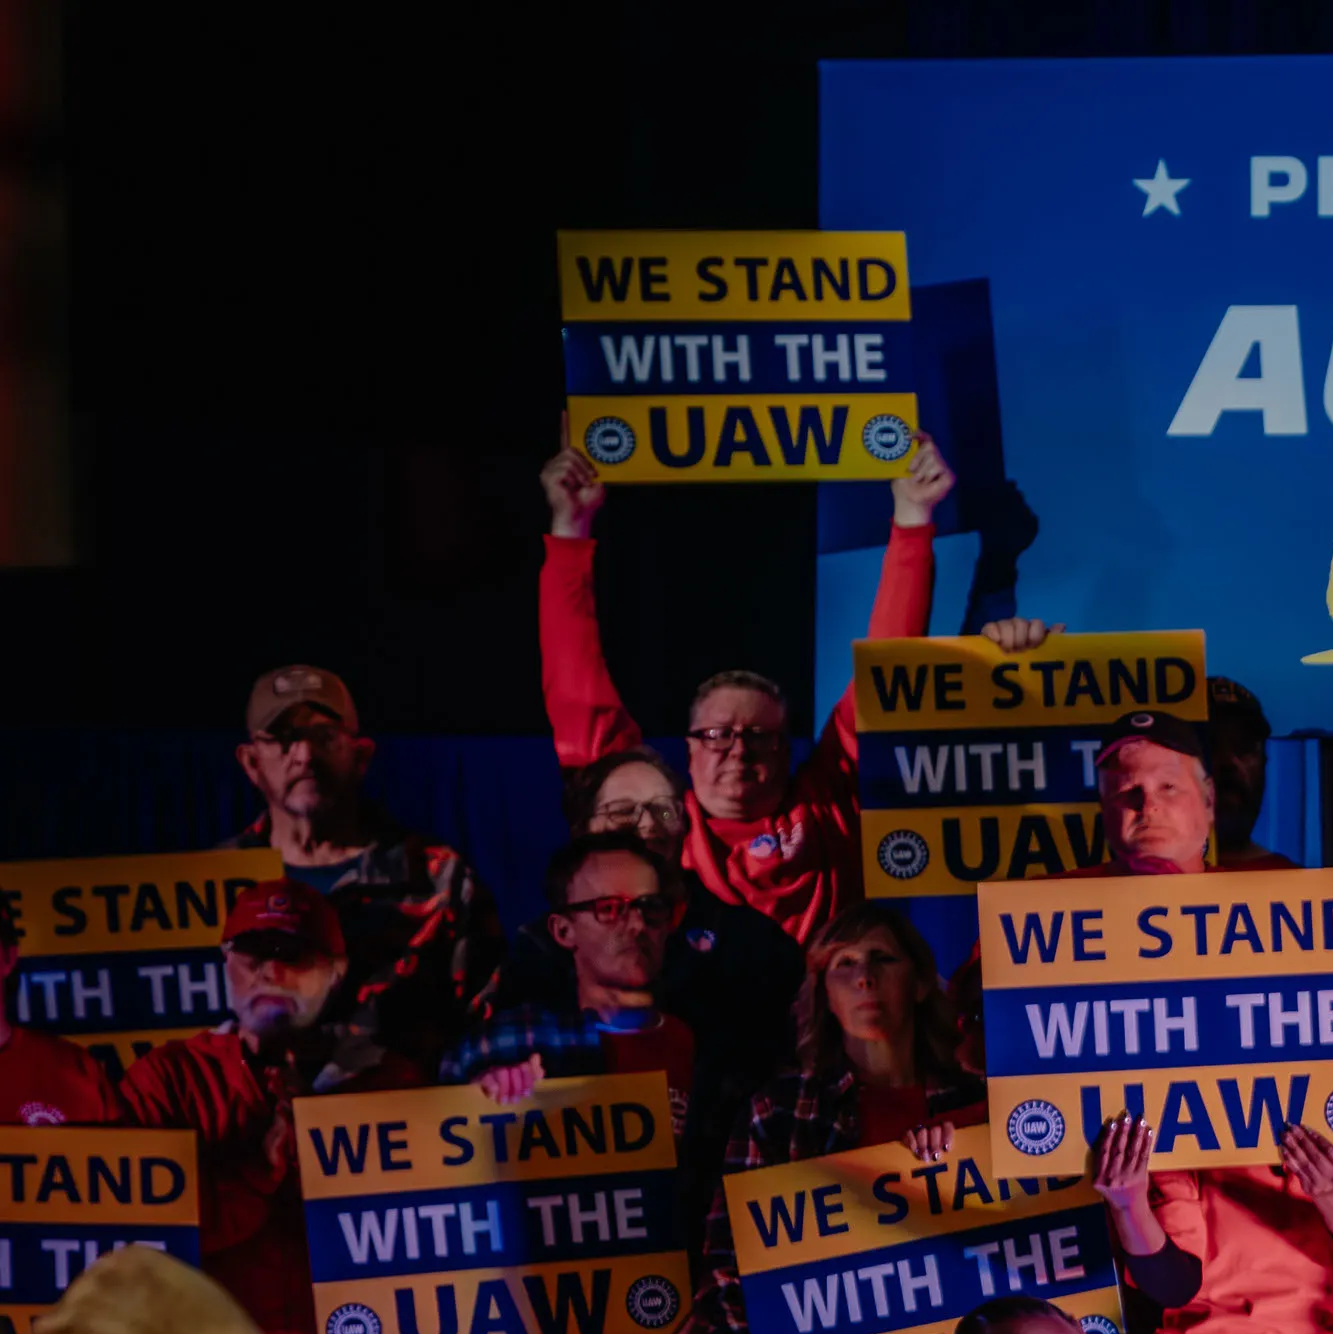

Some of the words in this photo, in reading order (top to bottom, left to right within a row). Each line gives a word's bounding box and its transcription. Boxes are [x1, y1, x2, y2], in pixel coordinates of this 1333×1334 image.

[576, 256, 671, 302] WE
[696, 256, 898, 302] STAND
[600, 333, 753, 384] WITH
[774, 332, 888, 383] THE
[649, 405, 850, 468] UAW
[871, 664, 966, 712] WE
[991, 657, 1196, 709] STAND
[894, 741, 1048, 795] WITH
[999, 911, 1106, 965] WE
[17, 968, 116, 1023] ITH
[137, 962, 234, 1016] TH
[1025, 997, 1199, 1060] WITH
[308, 1121, 412, 1177] WE
[440, 1103, 655, 1167] STAND
[1024, 1121, 1047, 1135] UAW
[0, 1154, 187, 1206] TAND
[747, 1182, 850, 1251] WE
[872, 1157, 1084, 1226] STA
[336, 1199, 502, 1265] WITH
[526, 1186, 649, 1248] THE
[964, 1224, 1087, 1298] THE
[642, 1294, 665, 1309] UAW
